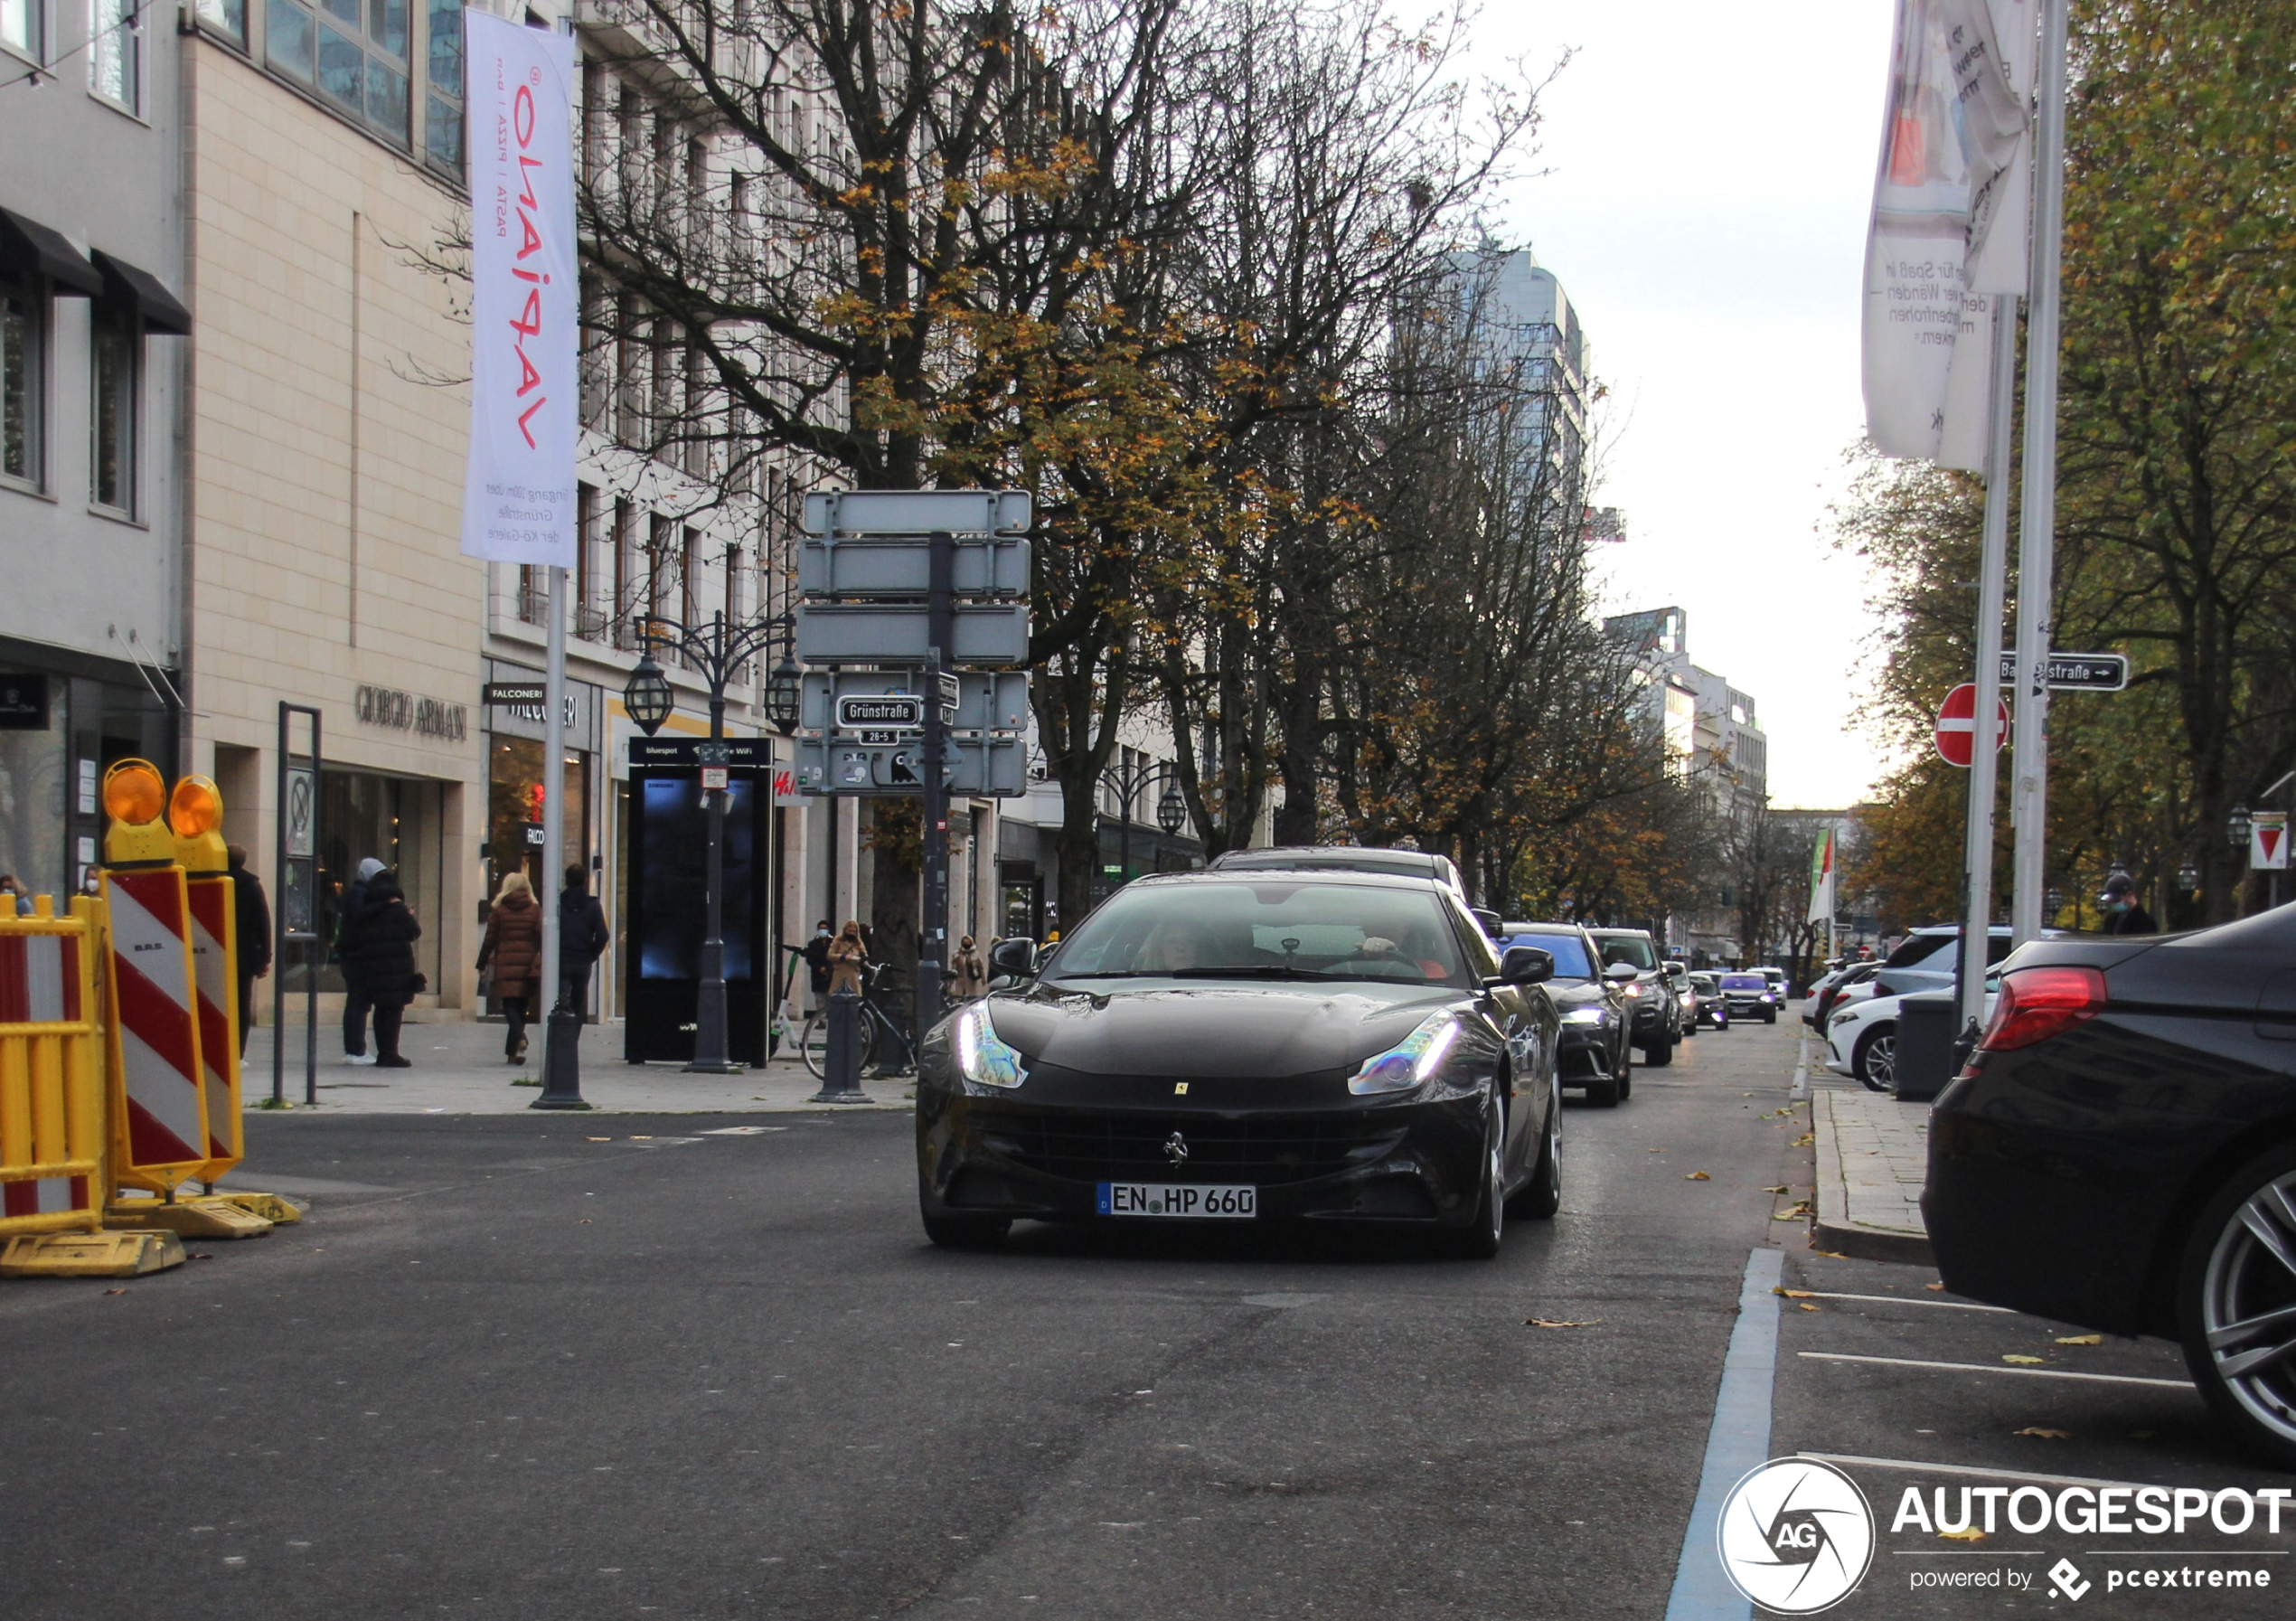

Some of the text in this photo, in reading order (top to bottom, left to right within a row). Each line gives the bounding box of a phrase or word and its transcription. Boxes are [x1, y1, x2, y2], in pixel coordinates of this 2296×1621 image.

[2000, 662, 2090, 680] Bastraße
[493, 689, 542, 699] FALCONERI
[356, 684, 413, 730] GIORGIO
[416, 696, 467, 741] ARMANI
[850, 703, 908, 719] Grünstraße
[870, 731, 889, 741] 26-5
[646, 746, 678, 756] bluespot
[736, 747, 753, 755] WiFi
[1113, 1186, 1147, 1211] EN
[1164, 1188, 1199, 1213] HP
[1204, 1189, 1254, 1214] 660
